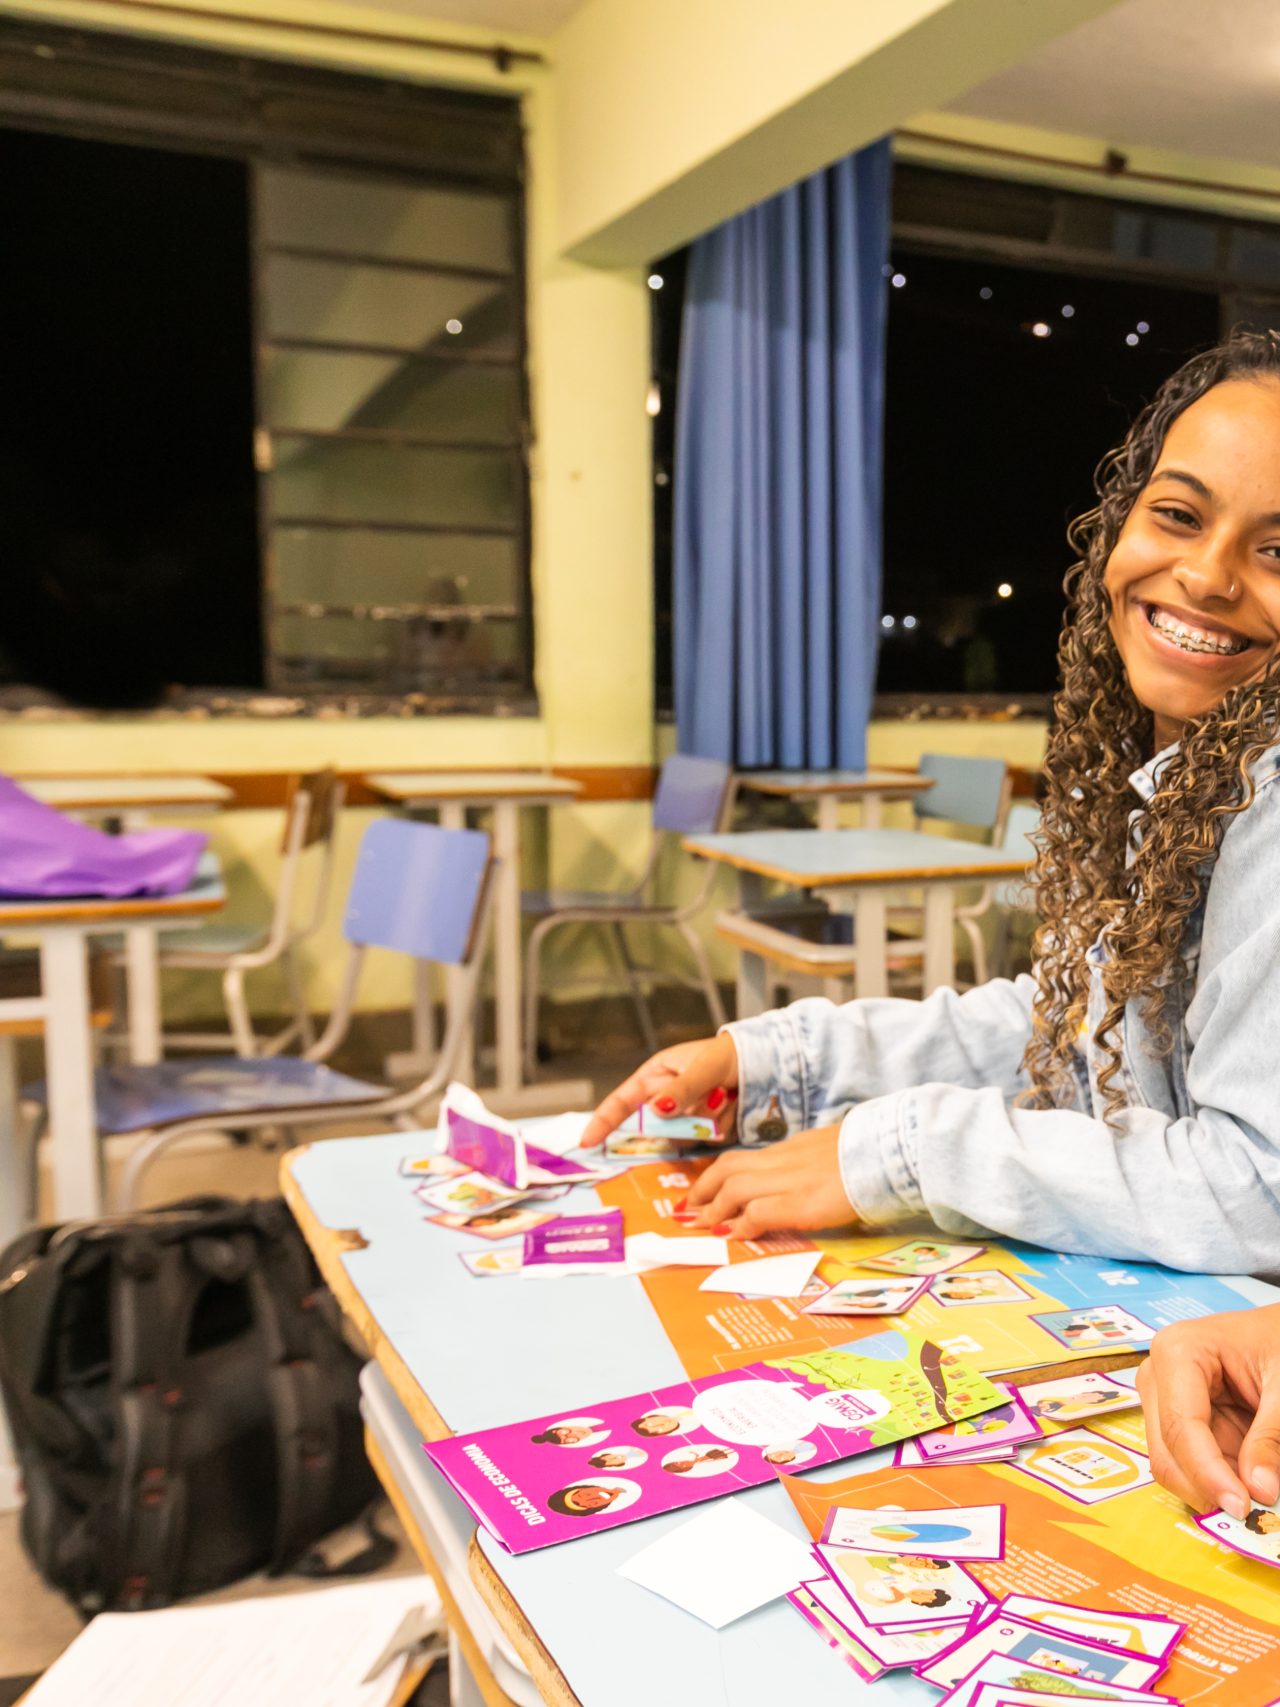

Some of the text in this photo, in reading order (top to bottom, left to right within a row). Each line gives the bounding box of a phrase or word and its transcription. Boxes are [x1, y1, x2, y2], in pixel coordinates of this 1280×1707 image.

[462, 1443, 547, 1526] DICAS DE ECONOMIA
